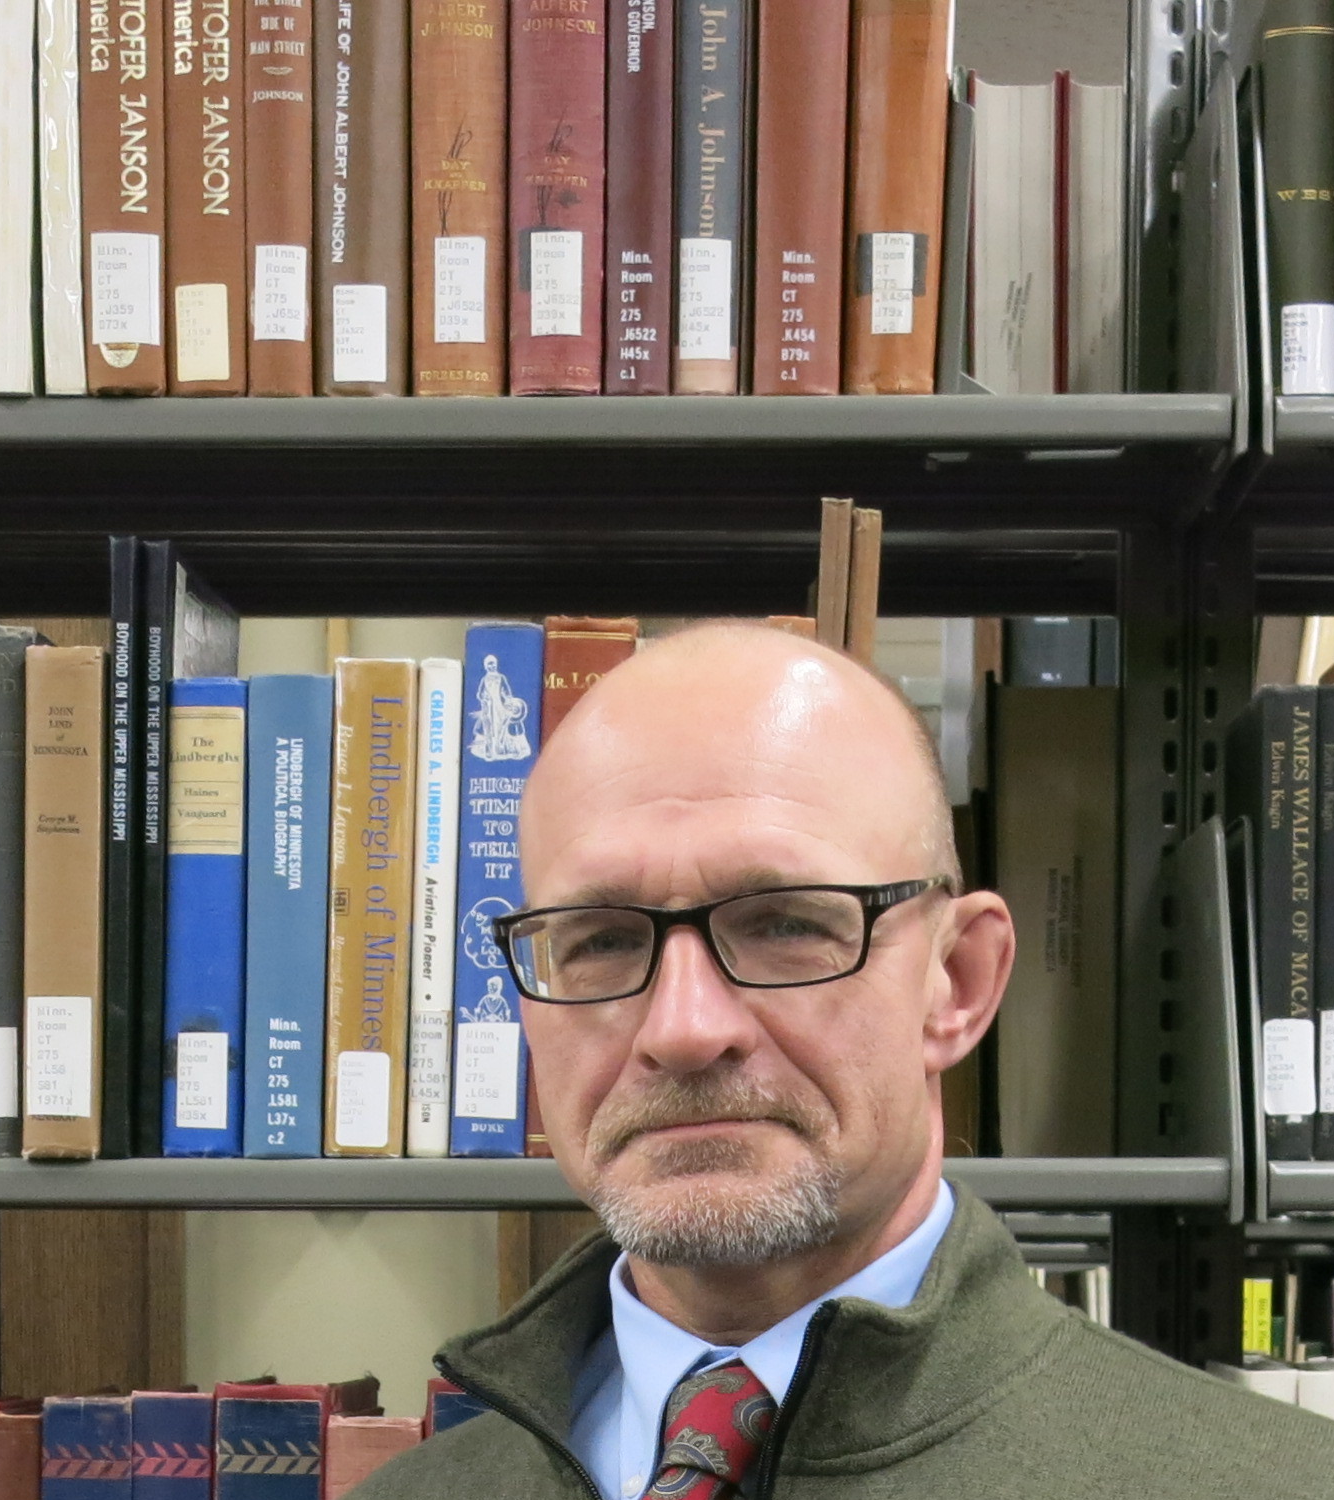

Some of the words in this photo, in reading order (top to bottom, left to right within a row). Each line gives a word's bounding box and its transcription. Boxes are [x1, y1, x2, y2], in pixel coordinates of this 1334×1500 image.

[337, 33, 351, 55] OF
[699, 3, 727, 71] John
[335, 61, 351, 108] JOHN
[699, 85, 726, 112] A.
[119, 94, 147, 213] JANSON
[202, 97, 229, 215] JANSON
[333, 112, 349, 178] ALBERT
[697, 123, 726, 239] Johnson
[331, 183, 347, 262] JOHNSON
[115, 622, 129, 677] BOYHOOD
[114, 703, 128, 725] THE
[115, 682, 129, 698] ON
[113, 729, 127, 764] UPPER
[276, 737, 288, 746] A
[430, 690, 444, 753] CHARLES
[275, 750, 288, 807] POLITICAL
[289, 738, 303, 801] LINDBERGH
[361, 696, 404, 870] Lindbergh
[429, 760, 443, 775] A.
[112, 768, 127, 841] MISSISSIPPI
[289, 805, 302, 820] OF
[423, 782, 442, 869] LINDBERGH,
[273, 811, 287, 876] BIOGRAPHY
[288, 825, 302, 890] MINNESOTA
[365, 885, 396, 919] of
[423, 877, 438, 929] Aviation
[422, 934, 437, 981] Pioneer
